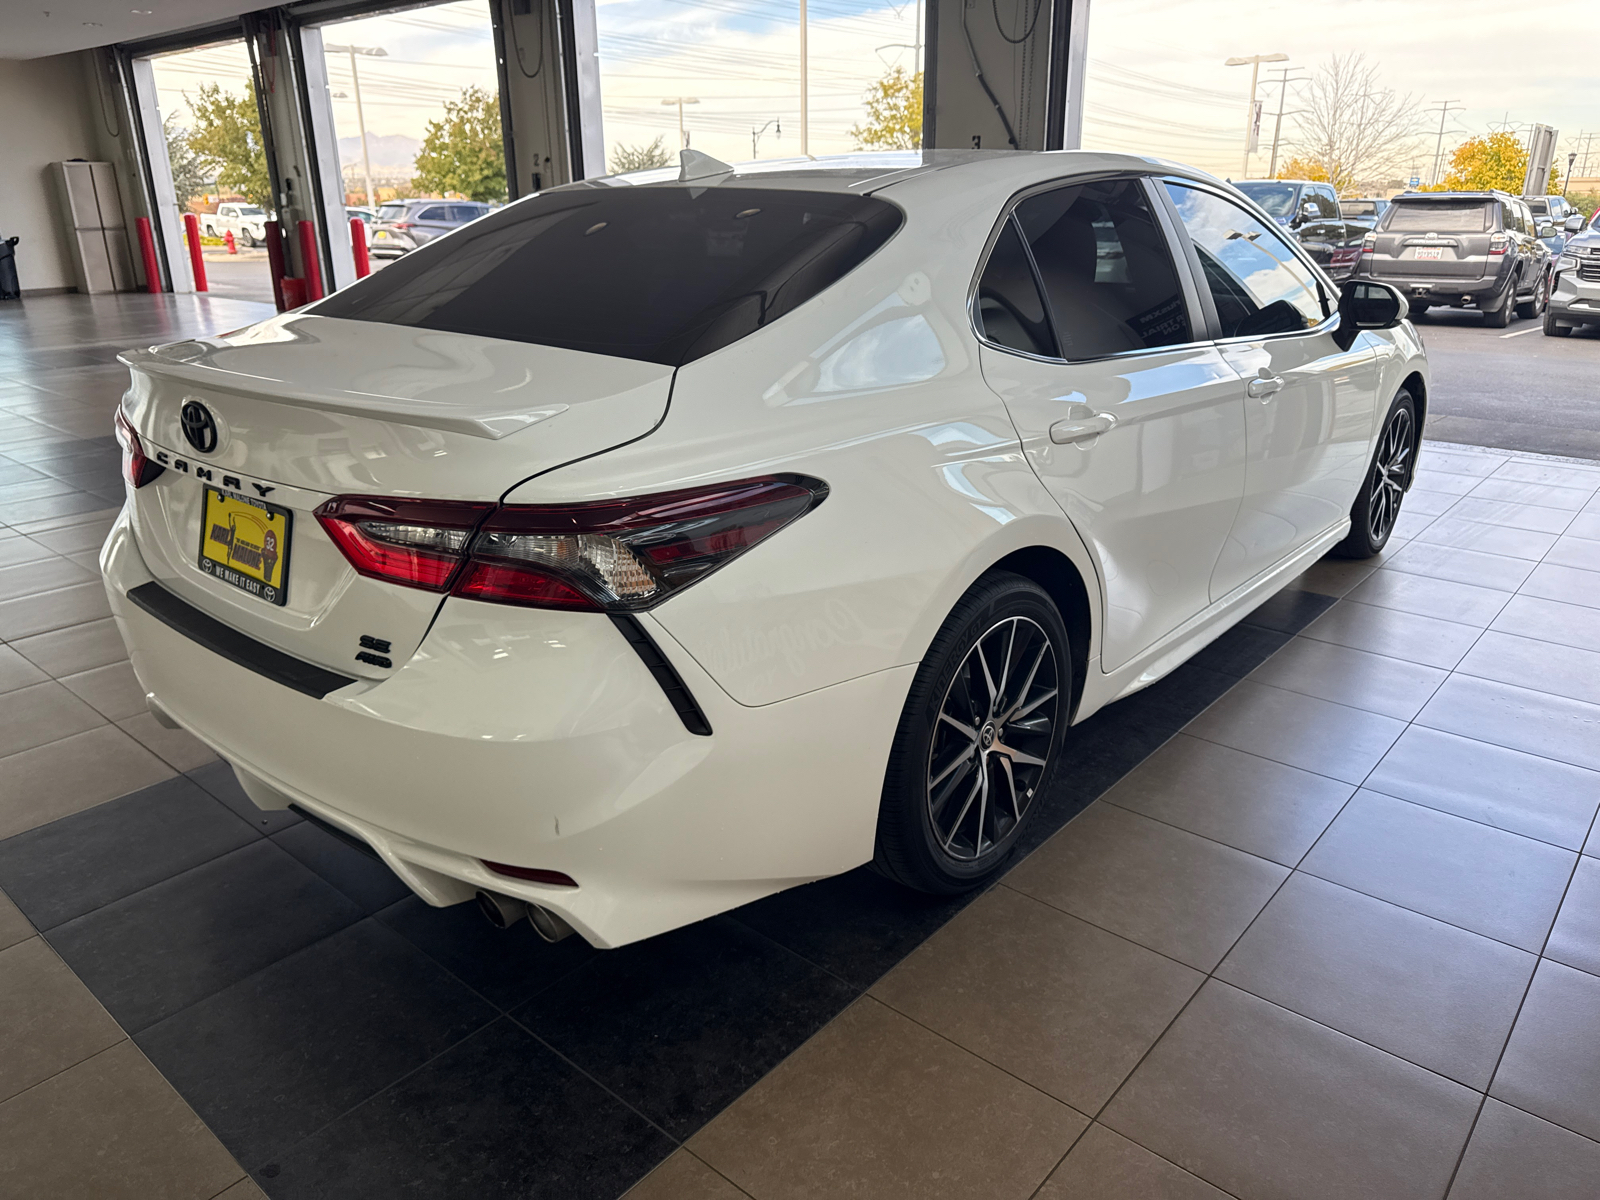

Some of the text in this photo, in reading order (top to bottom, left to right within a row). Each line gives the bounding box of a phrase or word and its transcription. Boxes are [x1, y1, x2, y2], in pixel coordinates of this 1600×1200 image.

[971, 135, 981, 149] 3
[533, 153, 540, 167] 2
[156, 451, 276, 497] CAMRY
[232, 491, 250, 505] MALONE
[210, 523, 231, 546] KARL
[266, 536, 275, 551] 32
[231, 542, 262, 571] MALONE
[215, 565, 261, 595] WE MAKE IT EASY
[358, 634, 392, 654] SE
[354, 650, 393, 669] AWD
[929, 617, 982, 712] KINERGY GT
